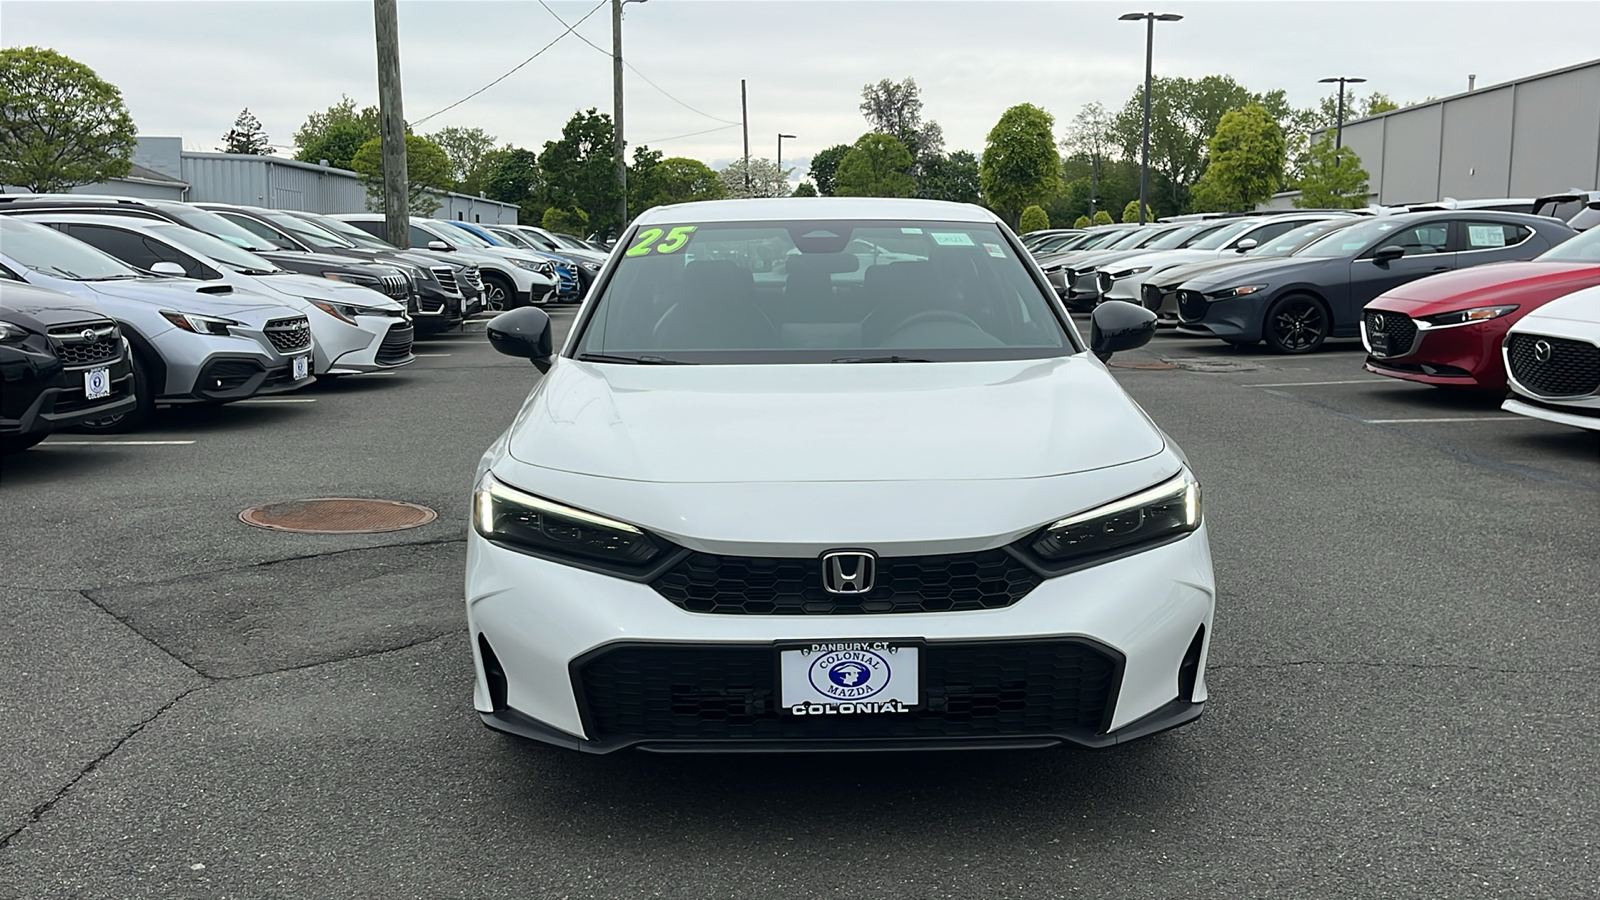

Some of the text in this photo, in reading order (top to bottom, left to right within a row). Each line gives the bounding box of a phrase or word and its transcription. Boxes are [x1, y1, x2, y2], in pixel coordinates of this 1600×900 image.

[626, 225, 698, 257] 25
[873, 641, 889, 651] CT
[819, 651, 881, 670] COLONIAL
[827, 684, 874, 698] MAZDA
[791, 702, 909, 716] COLONIAL
